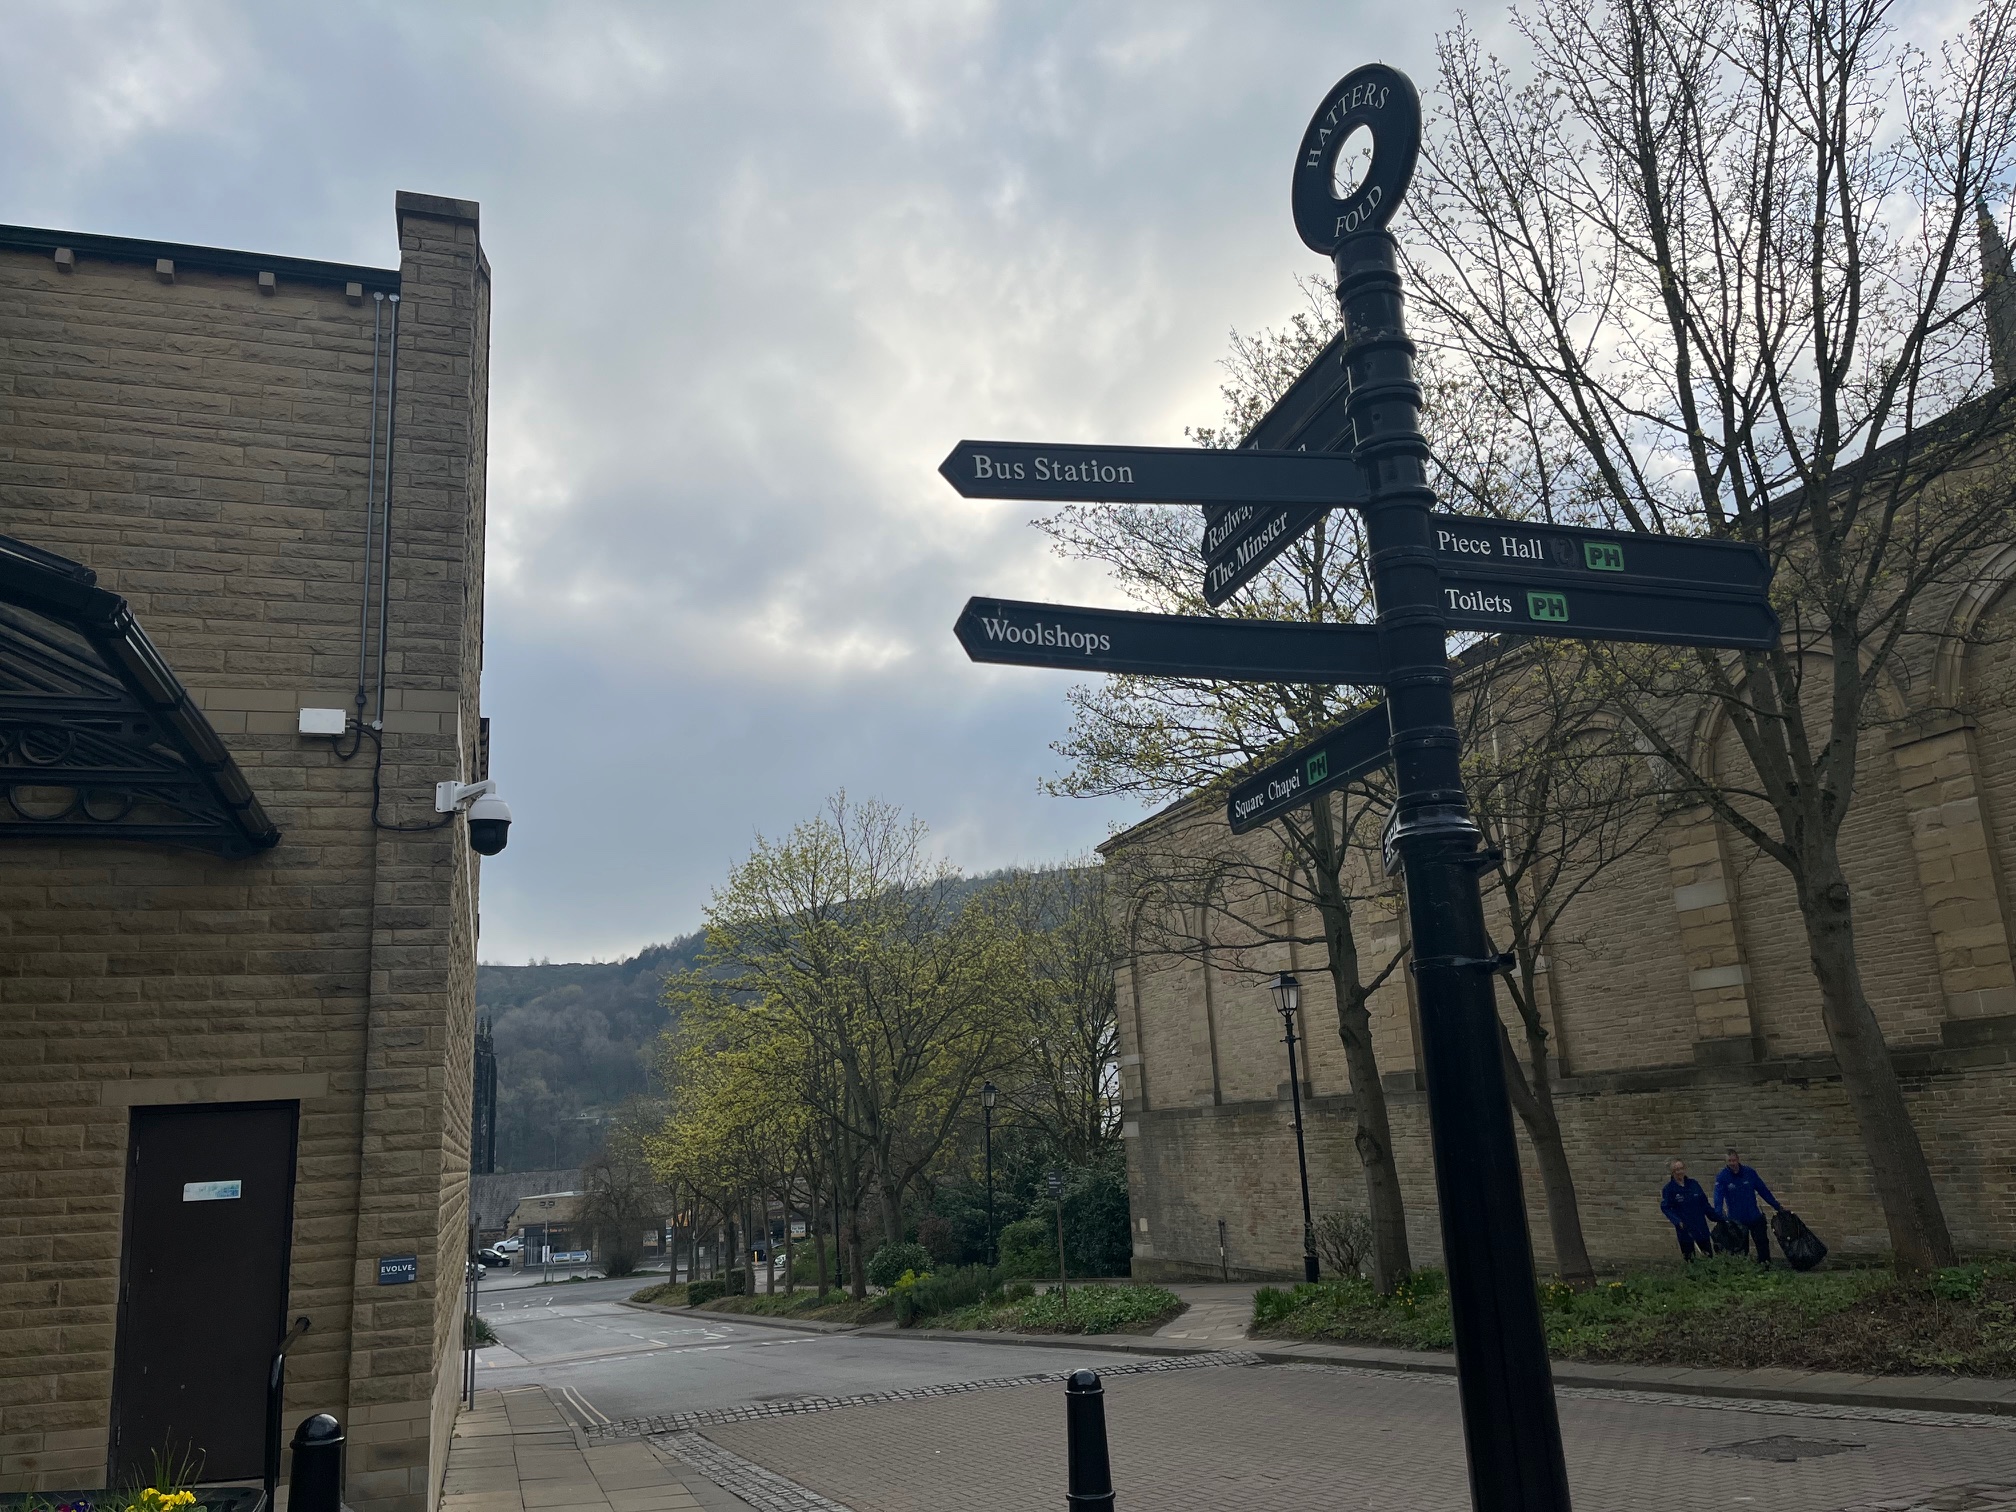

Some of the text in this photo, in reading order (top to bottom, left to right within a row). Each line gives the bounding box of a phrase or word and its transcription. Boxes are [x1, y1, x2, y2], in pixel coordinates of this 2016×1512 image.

[1306, 82, 1390, 168] HATTERS
[1334, 185, 1383, 238] FOLD
[972, 454, 1134, 484] Bus Station
[1208, 506, 1253, 553] Railway
[1209, 512, 1288, 593] The Minster
[1437, 530, 1621, 567] Piece Hall PH
[1445, 588, 1565, 618] Toilets PH
[981, 617, 1111, 655] Woolshops
[1235, 793, 1265, 819] Square
[1309, 755, 1327, 780] PH
